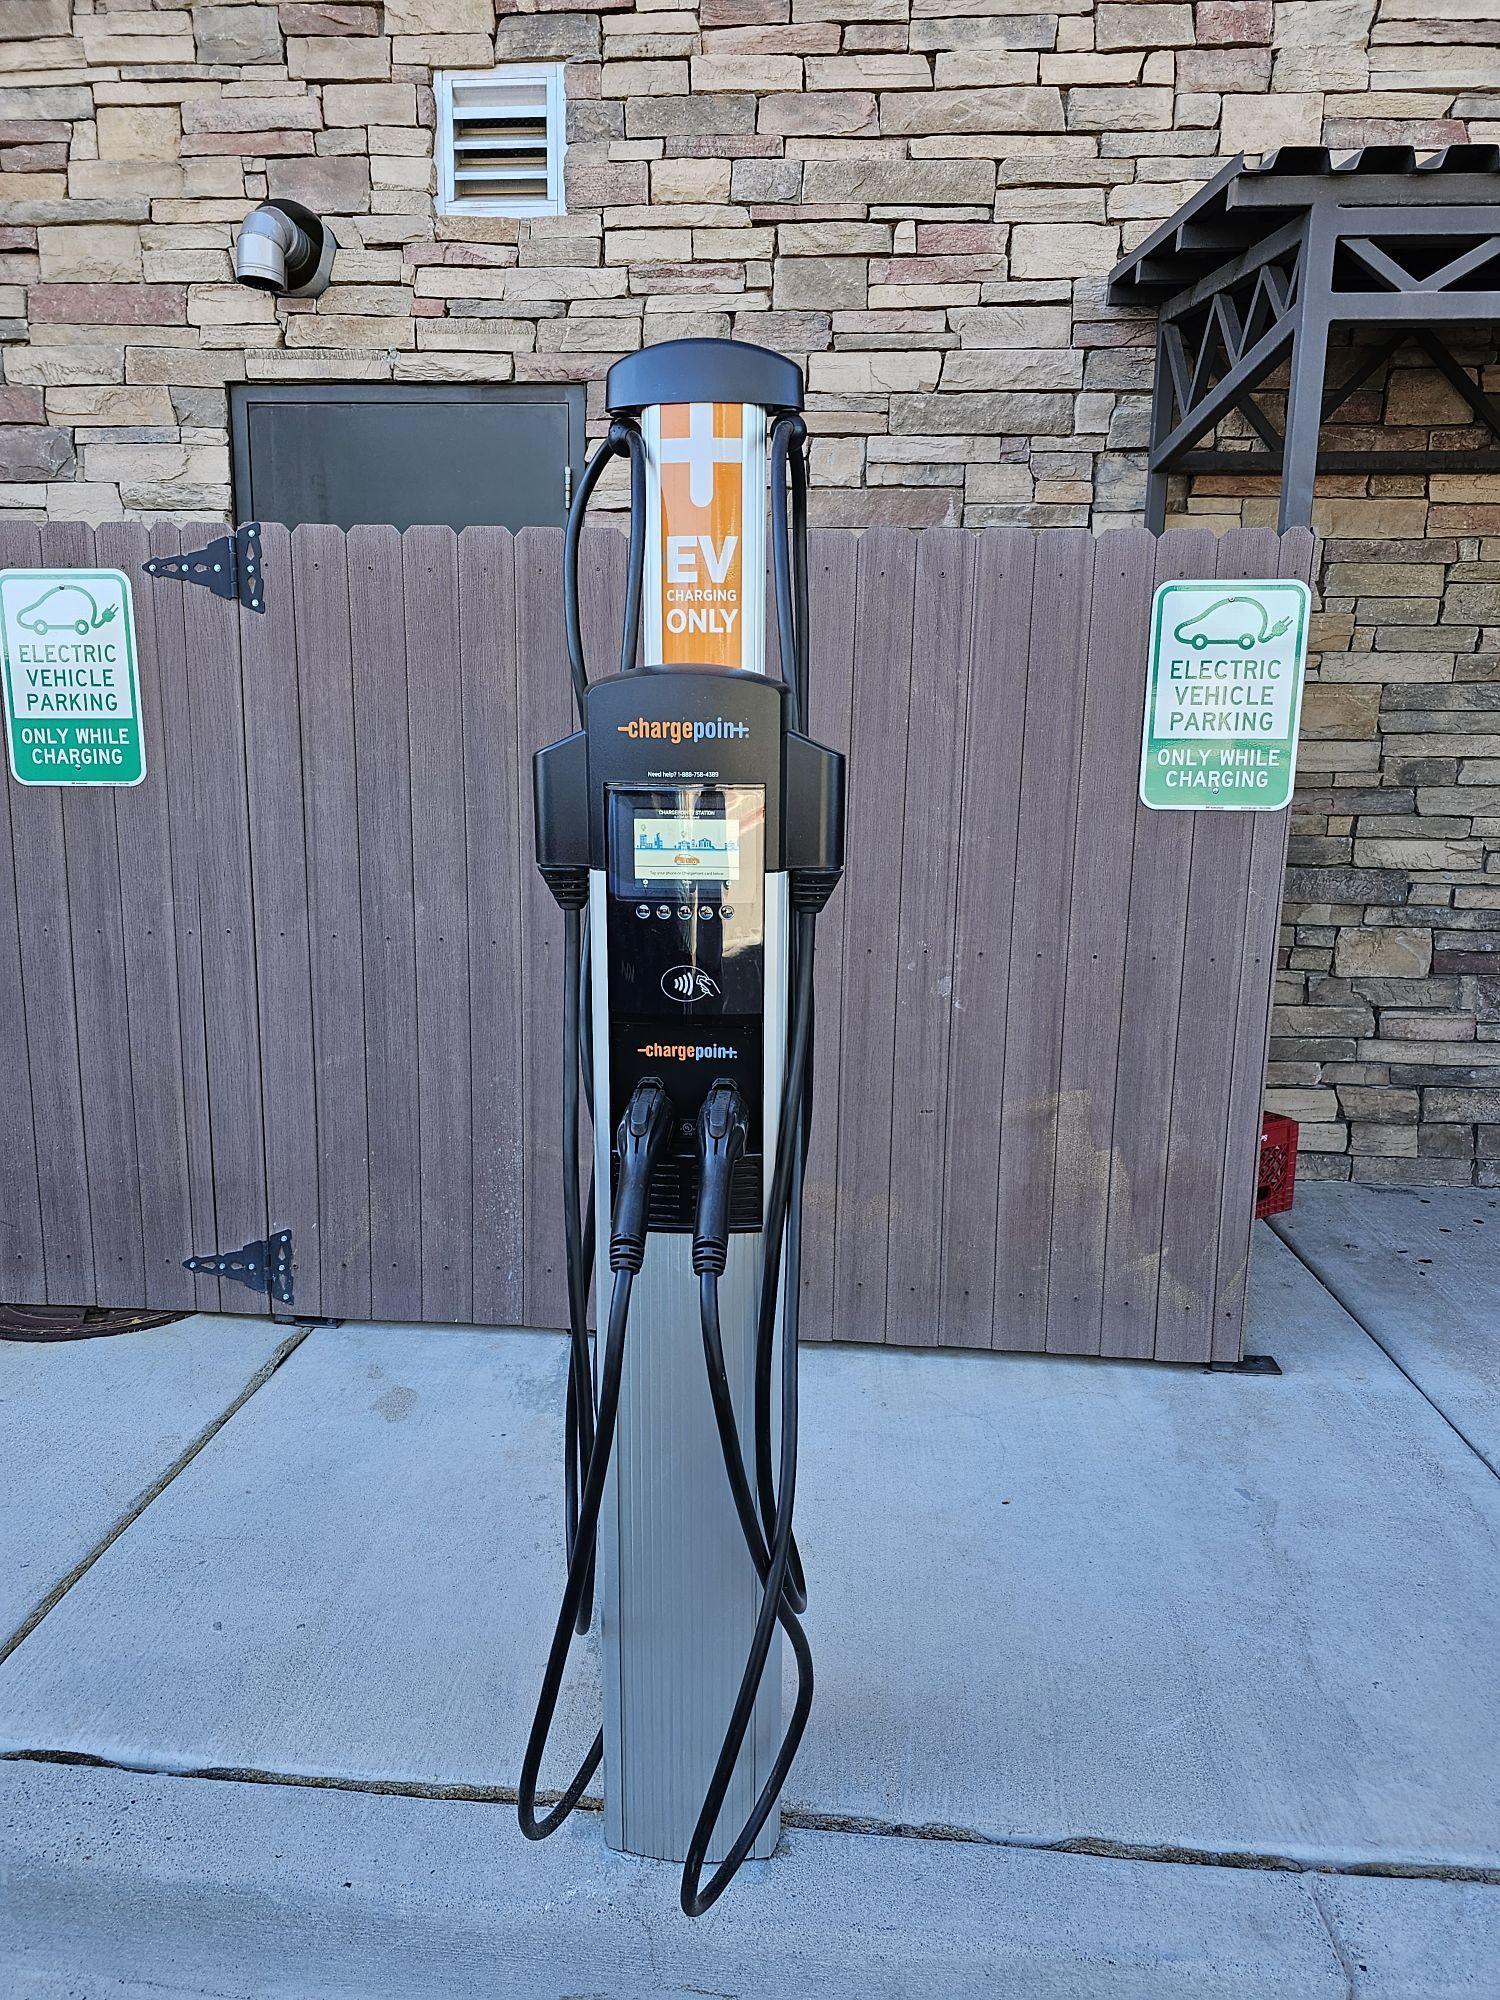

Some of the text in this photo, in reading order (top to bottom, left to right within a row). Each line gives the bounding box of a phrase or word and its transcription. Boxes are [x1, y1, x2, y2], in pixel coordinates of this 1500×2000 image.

[666, 535, 739, 584] EV
[666, 589, 737, 602] CHARGING
[666, 608, 739, 634] ONLY
[19, 644, 117, 663] ELECTRIC
[26, 669, 115, 687] VEHICLE
[1170, 660, 1282, 680] ELECTRIC
[27, 693, 118, 712] PARKING
[1175, 686, 1275, 706] VEHICLE
[1170, 712, 1273, 732] PARKING
[21, 728, 130, 745] ONLY WHILE
[32, 749, 123, 765] CHARGING
[1157, 749, 1280, 767] ONLY WHILE
[662, 771, 676, 779] help?
[1165, 771, 1269, 788] CHARGING
